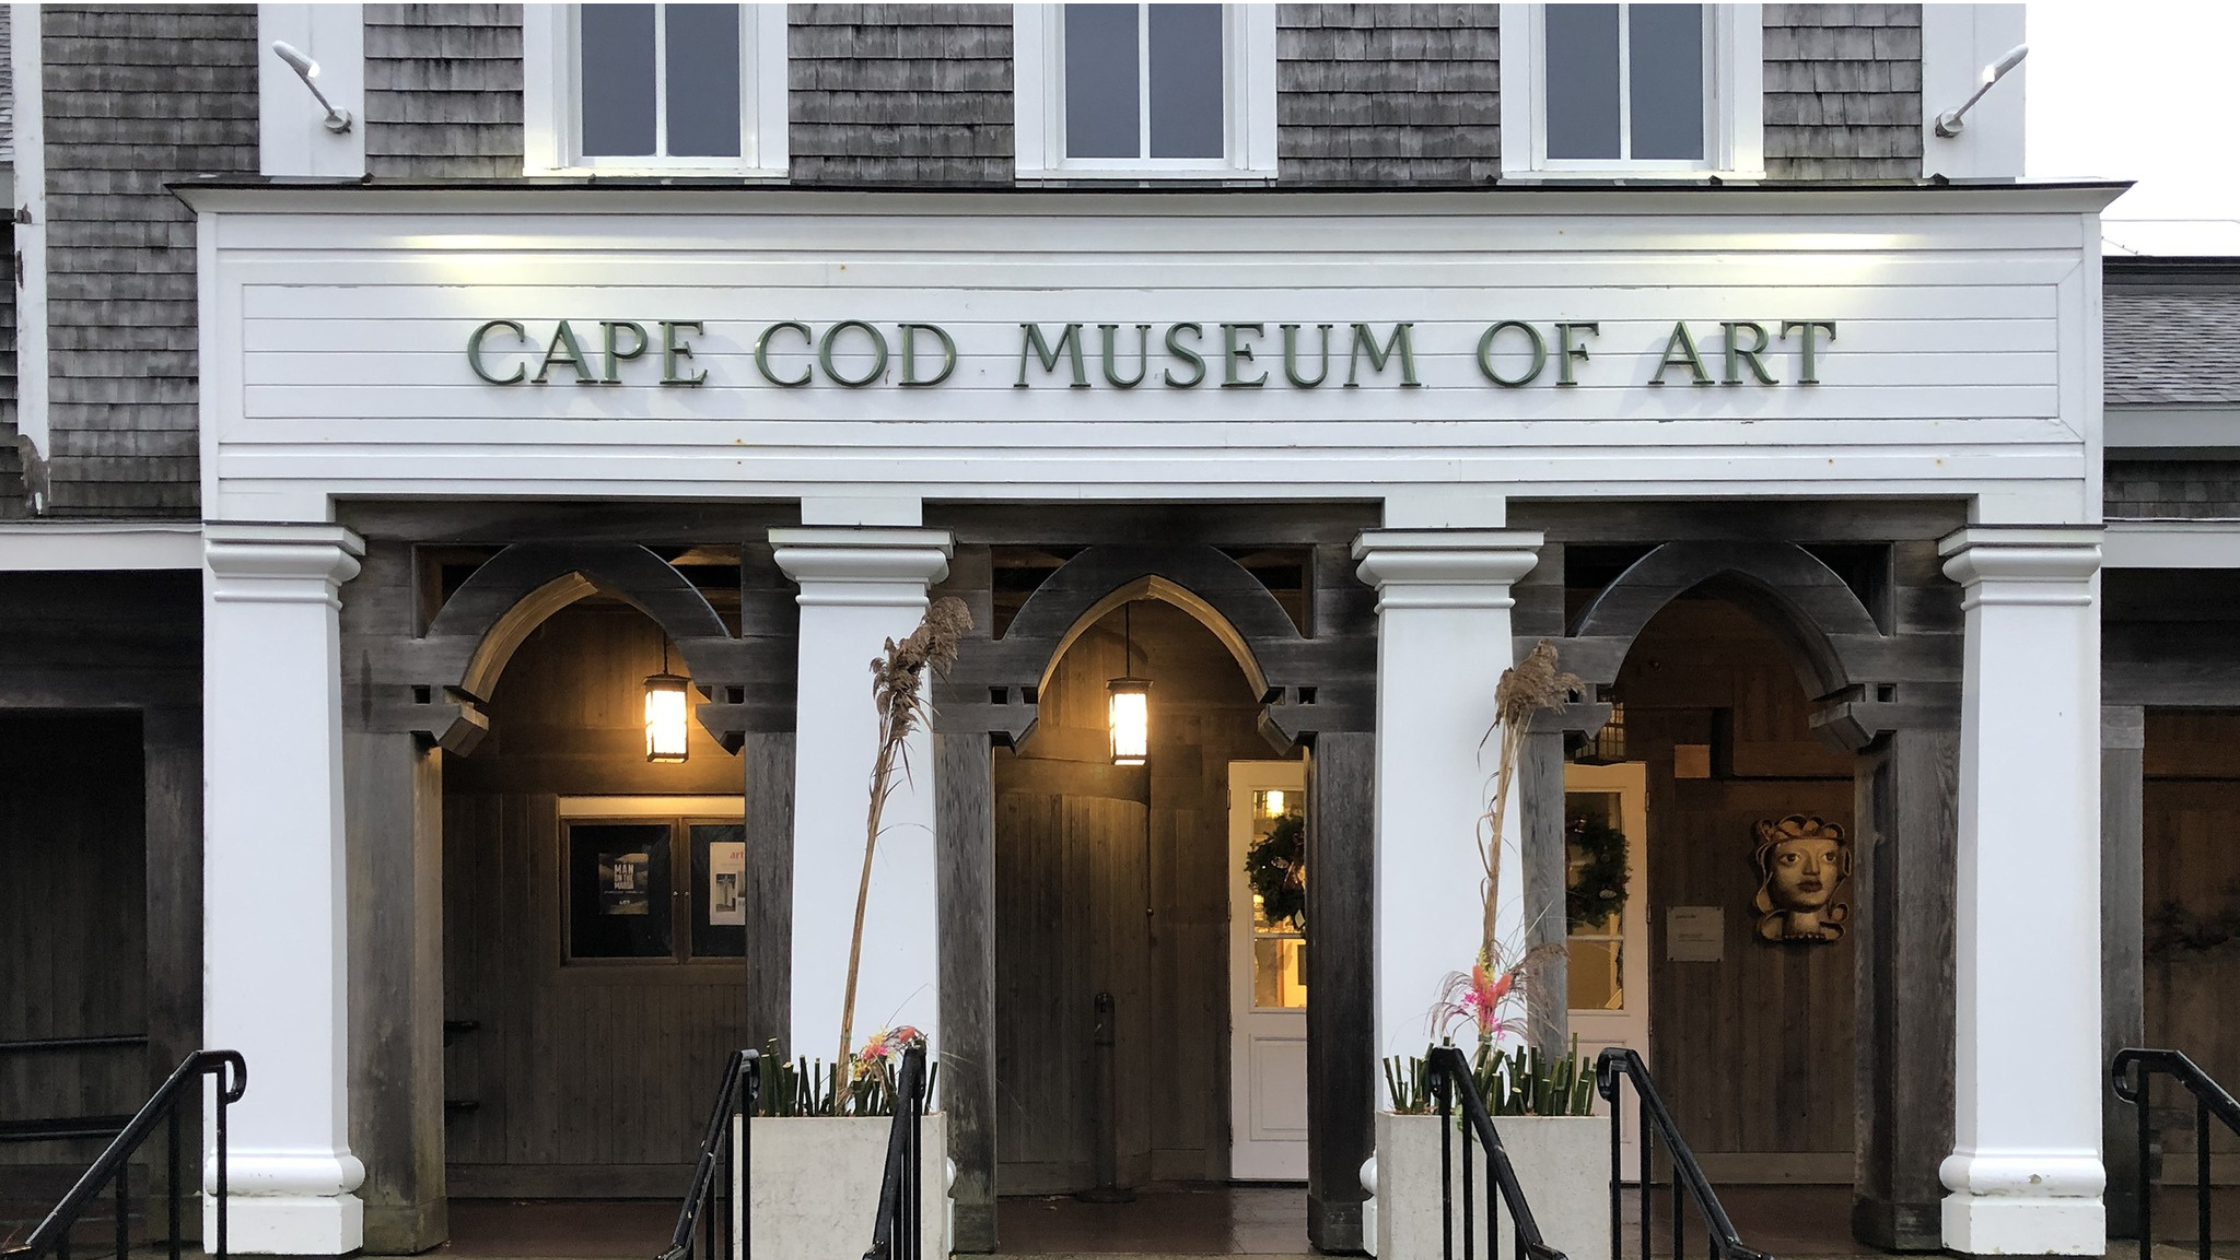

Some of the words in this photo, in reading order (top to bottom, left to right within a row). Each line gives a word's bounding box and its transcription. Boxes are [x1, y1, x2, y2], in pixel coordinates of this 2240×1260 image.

[467, 319, 708, 385] CAPE
[754, 320, 957, 387] COD
[1013, 322, 1422, 388] MUSEUM
[1477, 320, 1600, 388] OF
[1647, 319, 1836, 385] ART
[614, 864, 634, 875] MAN
